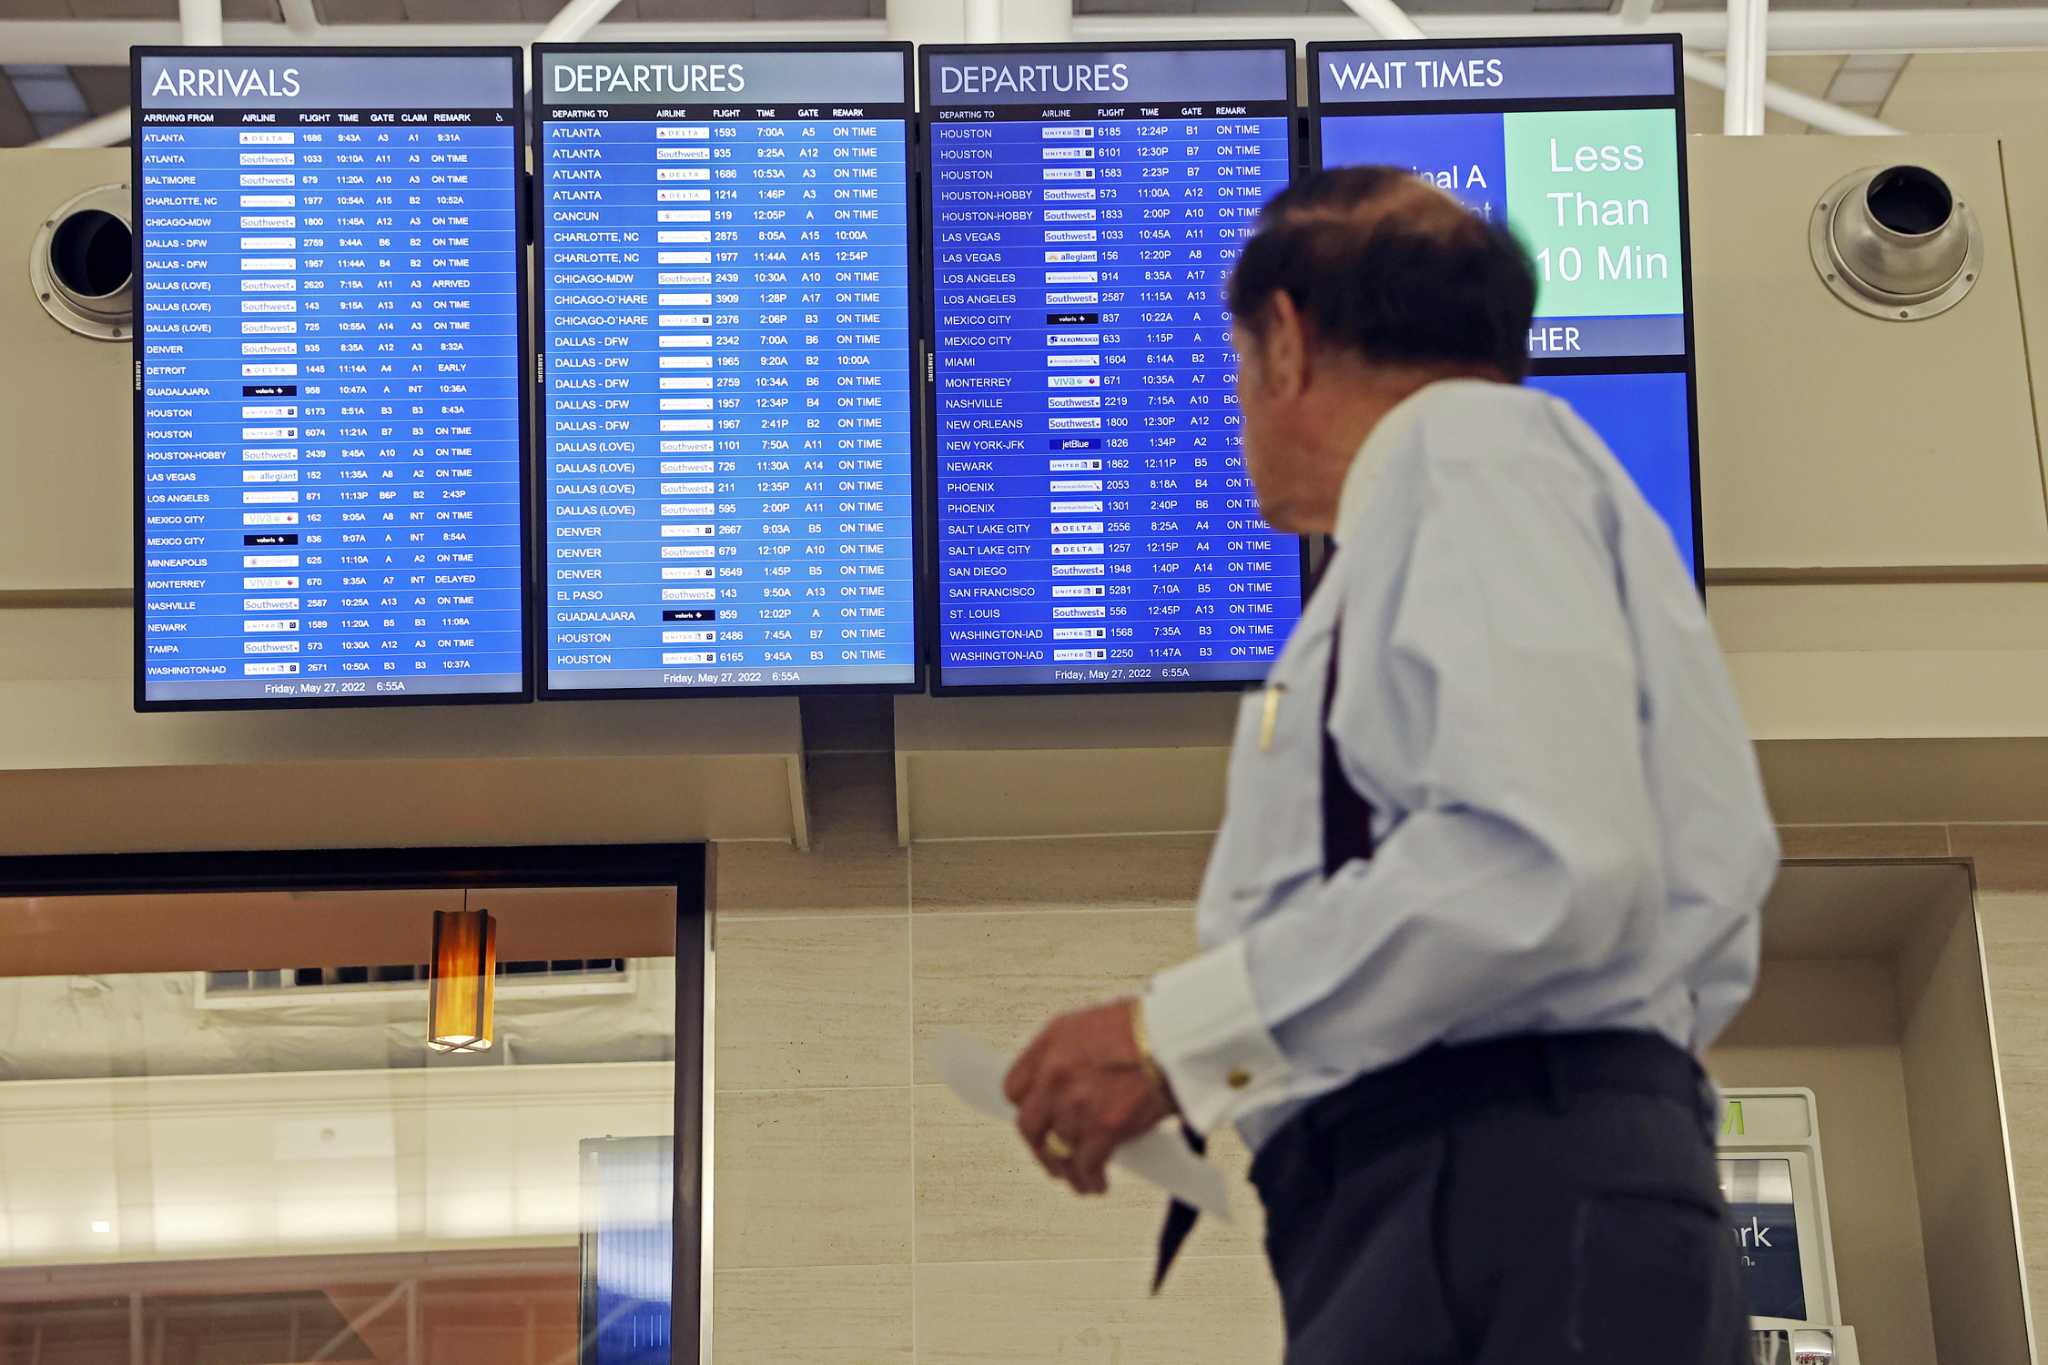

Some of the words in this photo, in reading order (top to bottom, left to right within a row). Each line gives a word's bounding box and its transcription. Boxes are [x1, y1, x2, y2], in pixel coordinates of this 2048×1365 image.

[554, 64, 745, 93] DEPARTURES
[940, 63, 1129, 93] DEPARTURES
[1329, 61, 1406, 91] WAIT
[1415, 59, 1504, 89] TIMES
[151, 69, 300, 97] ARRIVALS
[144, 114, 186, 123] ARRIVING
[188, 114, 214, 123] FROM
[242, 114, 276, 123] AIRLINE
[299, 114, 330, 123] FLIGHT
[338, 114, 359, 123] TIME
[370, 113, 394, 122] GATE
[401, 113, 428, 122] CLAIM
[433, 113, 472, 122] REMARK
[552, 109, 596, 118] DEPARTING
[598, 109, 609, 118] TO
[656, 109, 686, 118] AIRLINE
[713, 109, 740, 118] FLIGHT
[756, 109, 775, 118] TIME
[798, 109, 819, 117] GATE
[832, 108, 864, 117] REMARK
[939, 111, 983, 119] DEPARTING
[984, 110, 995, 119] TO
[1041, 109, 1071, 117] AIRLINE
[1098, 108, 1125, 117] FLIGHT
[1141, 108, 1159, 117] TIME
[1181, 107, 1202, 116] GATE
[1216, 106, 1246, 115] REMARK
[552, 149, 602, 158] ATLANTA
[658, 150, 705, 158] Southwest
[713, 148, 731, 157] 935
[757, 148, 785, 157] 9:25A
[800, 148, 818, 157] A12
[833, 148, 849, 157] ON
[852, 148, 877, 157] TIME
[940, 150, 993, 159] HOUSTON
[1098, 148, 1121, 157] 6101
[1137, 147, 1169, 156] 12:30P
[1187, 147, 1200, 155] B7
[1216, 146, 1234, 155] ON
[1235, 146, 1260, 154] TIME
[1549, 139, 1645, 173] Less
[145, 176, 196, 185] BALTIMORE
[431, 175, 446, 184] ON
[447, 175, 468, 184] TIME
[1465, 166, 1487, 189] A
[941, 191, 1032, 200] HOUSTON-HOBBY
[1044, 190, 1091, 199] Southwest
[1100, 189, 1117, 197] 573
[1137, 188, 1170, 197] 11:00A
[1184, 188, 1203, 197] A12
[1218, 188, 1235, 197] ON
[1237, 188, 1262, 196] TIME
[1546, 192, 1649, 227] Than
[942, 253, 962, 262] LAS
[964, 253, 1001, 262] VEGAS
[1060, 253, 1096, 262] allegiant
[1101, 251, 1119, 260] 156
[1139, 251, 1171, 259] 12:20P
[1189, 250, 1202, 259] A8
[1219, 250, 1236, 258] ON
[1537, 248, 1583, 282] 10
[1597, 246, 1668, 280] Min
[944, 358, 976, 366] MIAMI
[1104, 355, 1127, 363] 1604
[1147, 354, 1174, 363] 6:14A
[1191, 354, 1205, 362] B2
[946, 441, 971, 449] NEW
[973, 440, 1025, 449] YORK-JFK
[1062, 440, 1089, 448] jetBlue
[1105, 439, 1129, 447] 1826
[1150, 438, 1176, 447] 1:34P
[1193, 438, 1207, 446] A2
[555, 463, 598, 472] DALLAS
[599, 463, 635, 472] (LOVE)
[661, 463, 709, 472] Southwest
[718, 462, 736, 471] 726
[757, 462, 790, 470] 11:30A
[804, 461, 824, 470] A14
[839, 461, 856, 470] ON
[857, 461, 883, 469] TIME
[948, 546, 974, 554] SALT
[977, 546, 1004, 554] LAKE
[1007, 545, 1031, 554] CITY
[1062, 545, 1093, 553] DELTA
[1108, 543, 1131, 552] 1257
[1146, 543, 1179, 551] 12:15P
[1196, 542, 1210, 551] A4
[1227, 542, 1244, 551] ON
[1246, 541, 1271, 550] TIME
[948, 567, 971, 576] SAN
[973, 567, 1007, 575] DIEGO
[1052, 566, 1100, 575] Southwest
[1153, 564, 1179, 572] 1:40P
[1194, 563, 1213, 572] A14
[1228, 563, 1244, 571] ON
[1246, 562, 1272, 571] TIME
[557, 591, 570, 600] EL
[572, 591, 603, 599] PASO
[663, 590, 710, 599] Southwest
[720, 589, 737, 597] 143
[763, 588, 791, 597] 9:50A
[806, 587, 826, 596] A13
[840, 588, 857, 596] ON
[859, 587, 885, 596] TIME
[969, 609, 1000, 617] LOUIS
[1053, 608, 1101, 617] Southwest
[1110, 607, 1127, 616] 556
[1148, 606, 1180, 615] 12:45P
[1195, 605, 1214, 614] A13
[1229, 605, 1245, 613] ON
[1247, 604, 1273, 613] TIME
[148, 645, 179, 654] TAMPA
[437, 639, 452, 648] ON
[453, 639, 474, 648] TIME
[557, 655, 611, 664] HOUSTON
[720, 653, 744, 661] 6165
[764, 652, 792, 660] 9:45A
[810, 651, 824, 660] B3
[841, 651, 858, 660] ON
[860, 650, 886, 659] TIME
[663, 673, 696, 683] Friday,
[698, 673, 719, 683] May
[738, 672, 761, 682] 2022
[772, 671, 800, 682] 6:55A
[1055, 669, 1086, 680] Friday,
[1088, 669, 1109, 680] May
[1128, 668, 1151, 678] 2022
[1162, 667, 1190, 678] 6:55A
[264, 683, 298, 694] Friday,
[300, 683, 323, 694] May
